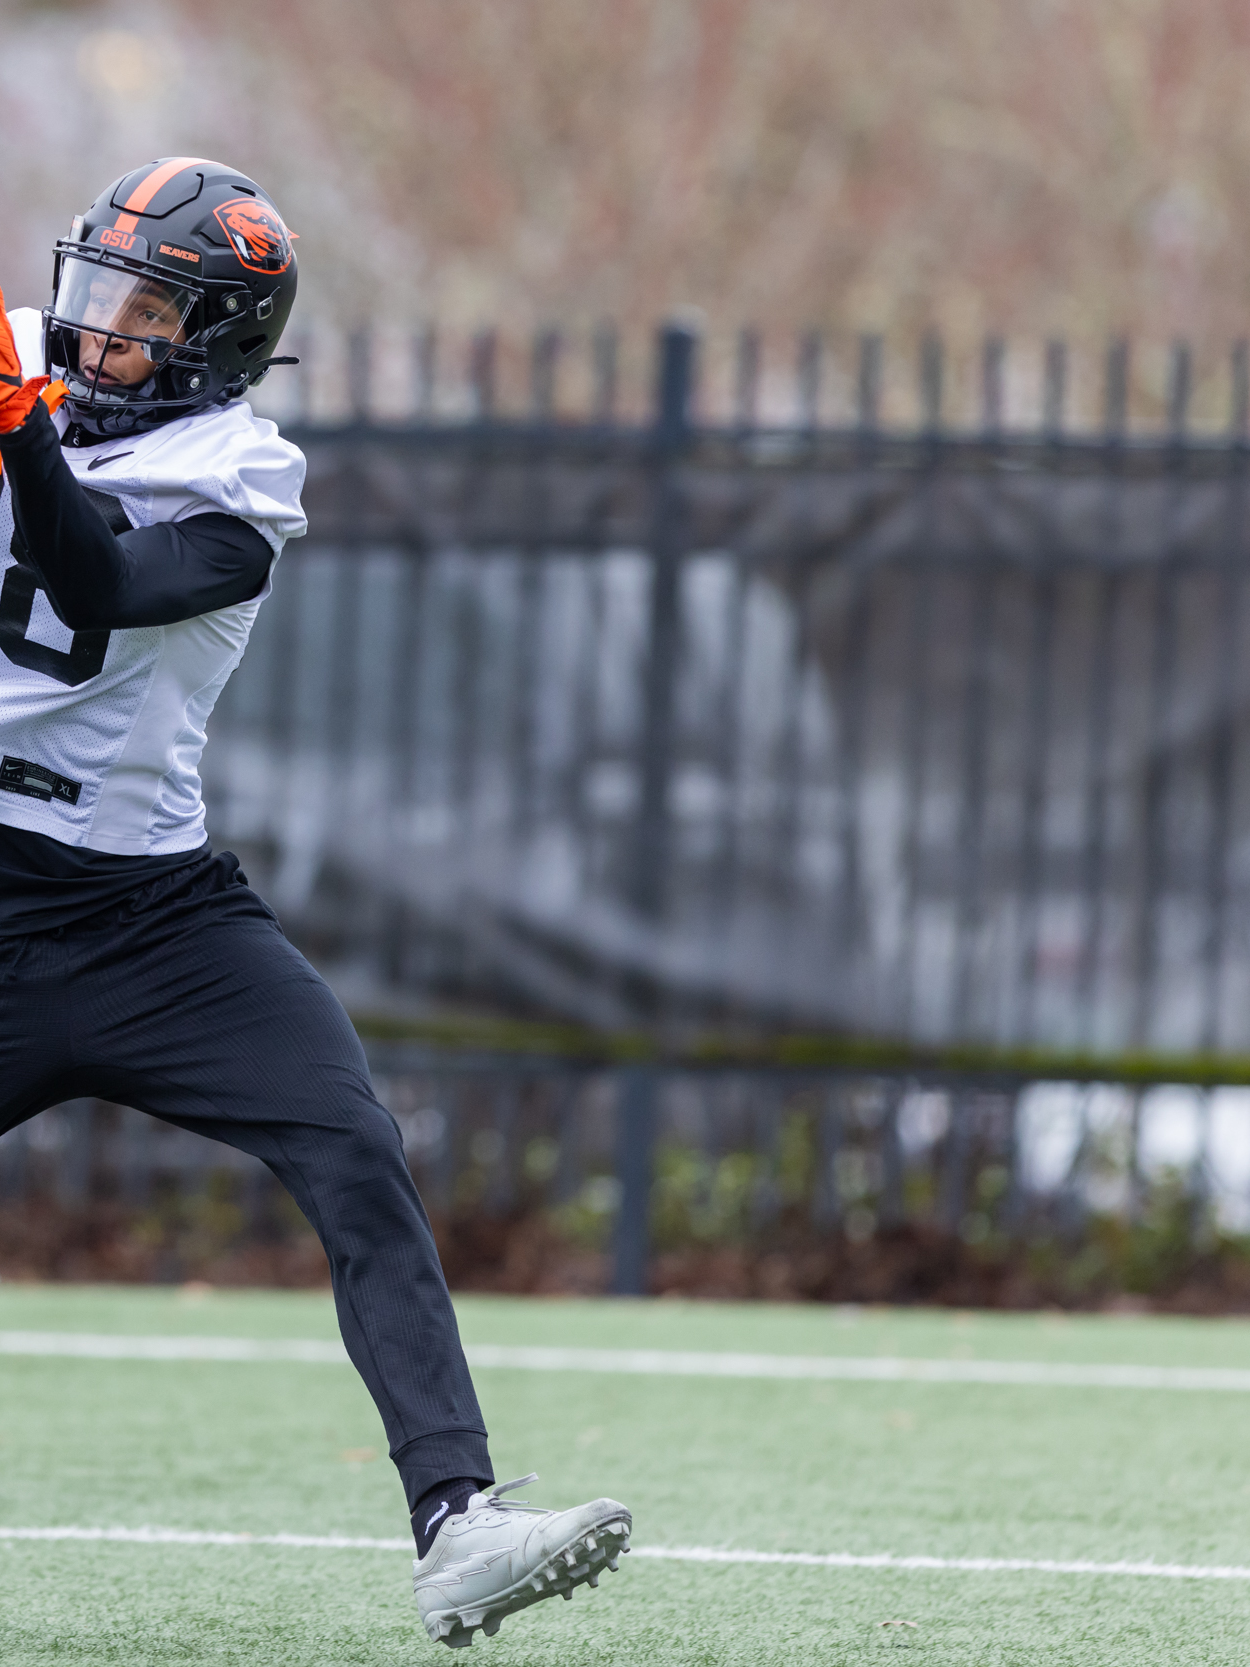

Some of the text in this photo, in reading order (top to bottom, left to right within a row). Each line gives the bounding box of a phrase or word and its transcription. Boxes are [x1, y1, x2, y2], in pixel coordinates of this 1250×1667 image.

[99, 229, 137, 251] OSU
[159, 244, 200, 263] BEAVERS
[58, 782, 72, 798] XL
